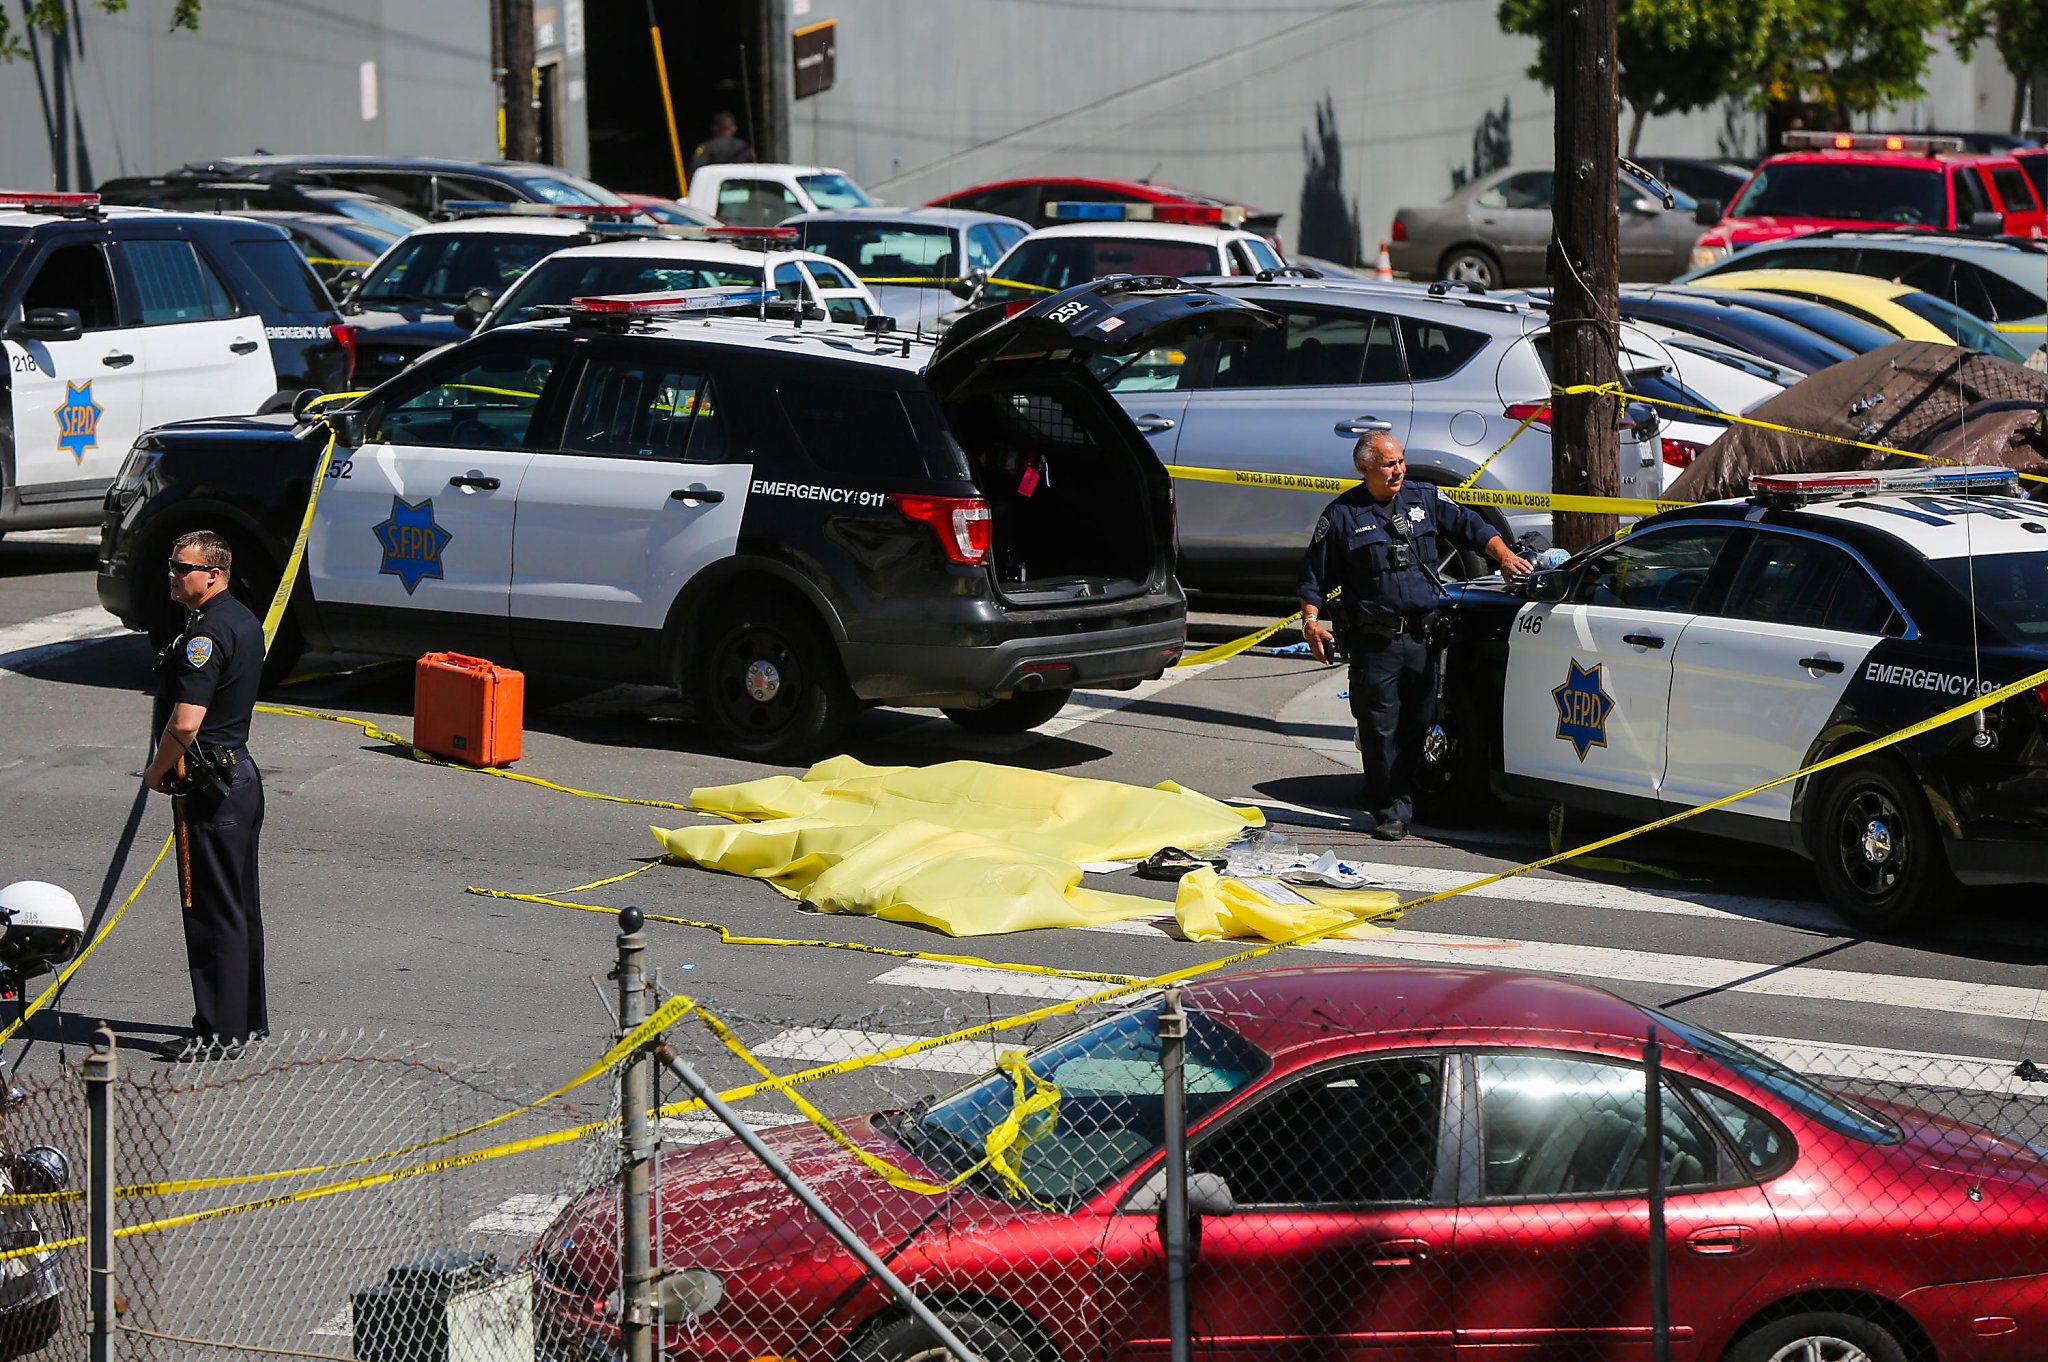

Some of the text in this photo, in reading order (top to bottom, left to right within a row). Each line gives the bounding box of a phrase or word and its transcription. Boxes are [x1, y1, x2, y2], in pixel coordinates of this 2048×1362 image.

[1049, 300, 1089, 323] 252
[12, 353, 37, 372] 218
[751, 479, 886, 507] EMERGENCY 911
[387, 525, 437, 561] S.F.P.D.
[1517, 614, 1543, 635] 146
[1865, 662, 1975, 696] EMERGENCY
[1562, 689, 1602, 729] S.F.P.D.
